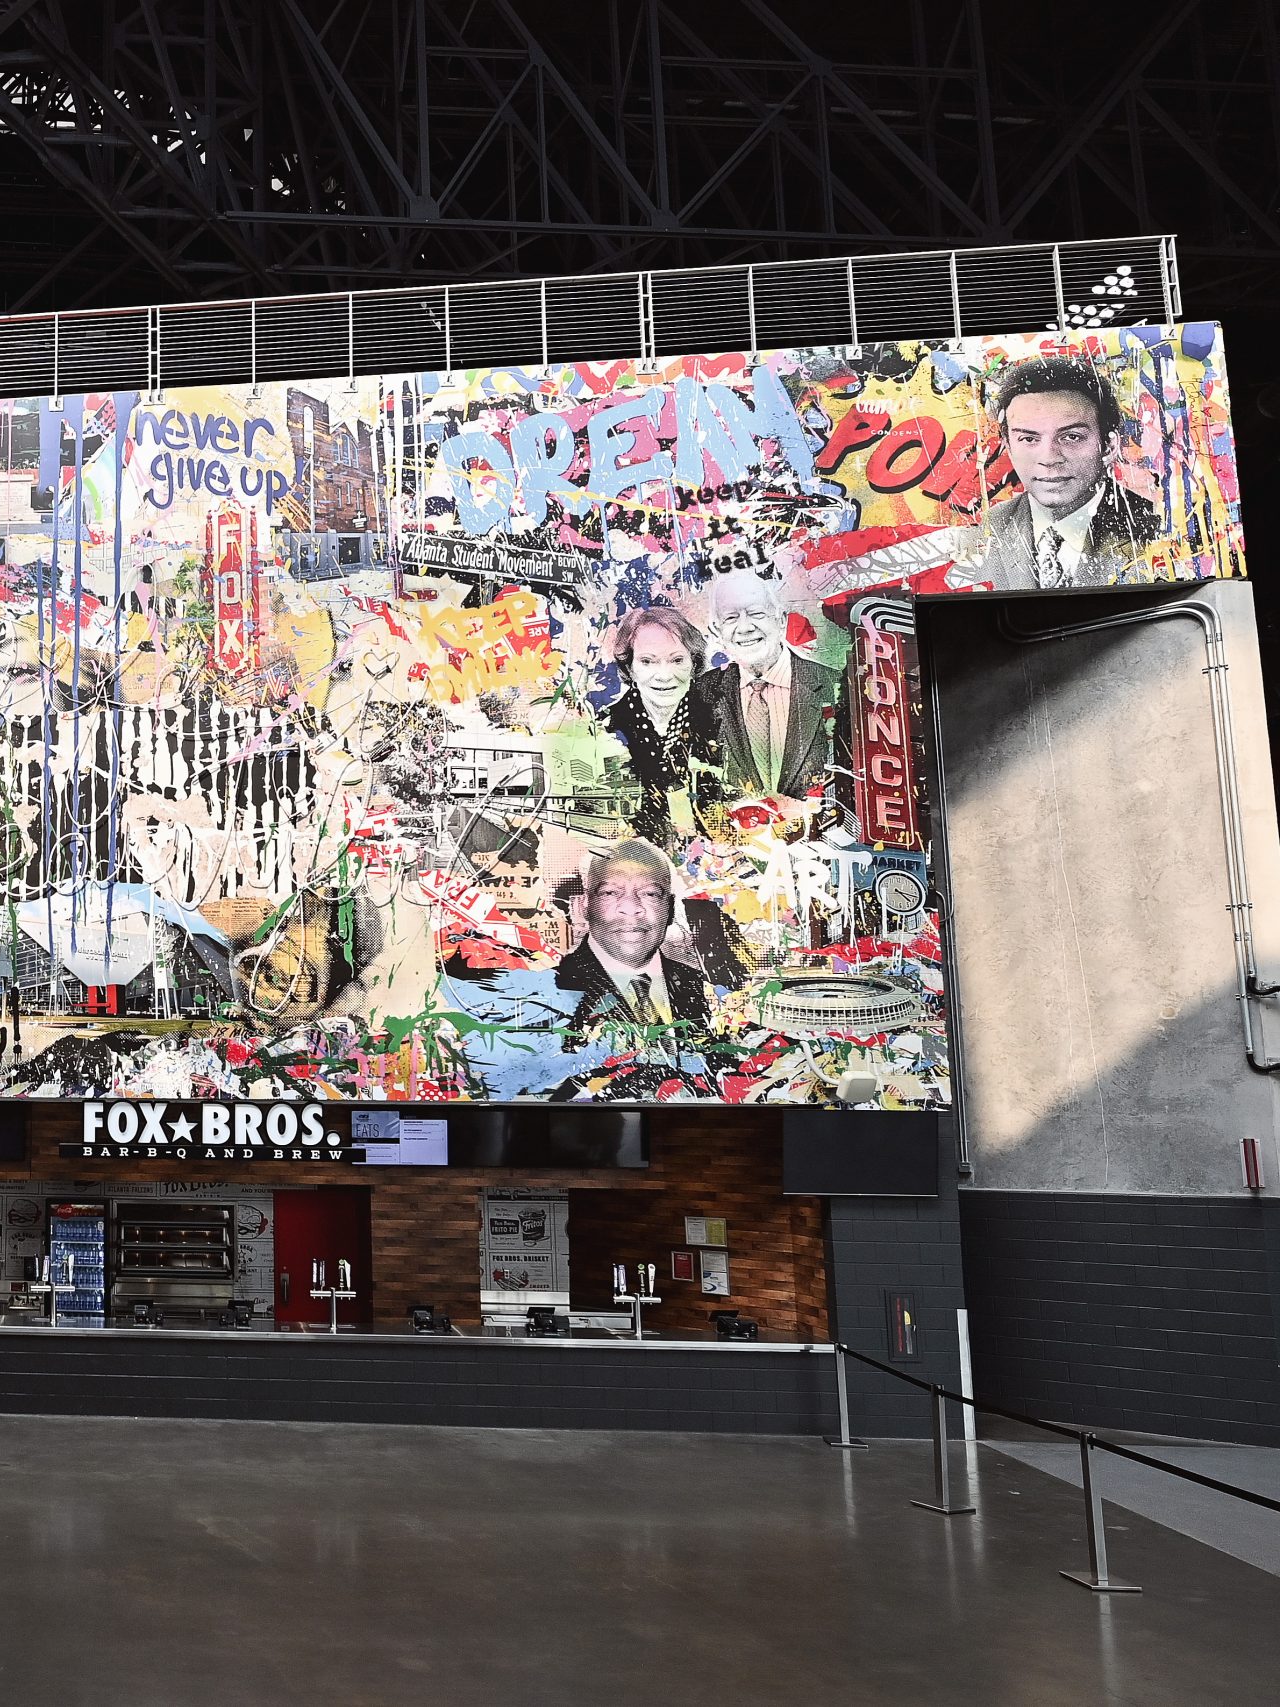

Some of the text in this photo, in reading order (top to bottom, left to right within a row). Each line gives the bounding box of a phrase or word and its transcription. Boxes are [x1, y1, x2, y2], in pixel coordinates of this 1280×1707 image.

[135, 409, 274, 457] never
[146, 452, 304, 516] give up!
[676, 480, 751, 510] keep
[707, 515, 744, 539] it
[406, 539, 448, 562] Atlanta
[452, 545, 496, 569] Student
[497, 551, 553, 578] Movement
[696, 542, 771, 580] real
[217, 524, 244, 660] FOX
[419, 591, 538, 655] KEEP
[864, 637, 907, 831] PONCE
[756, 836, 873, 913] ART
[82, 1102, 342, 1146] FOX BROS.
[356, 1123, 380, 1138] EATS
[82, 1147, 188, 1160] BAR-B-Q
[205, 1148, 254, 1160] AND
[274, 1149, 345, 1161] BREW
[522, 1219, 543, 1231] Fritos
